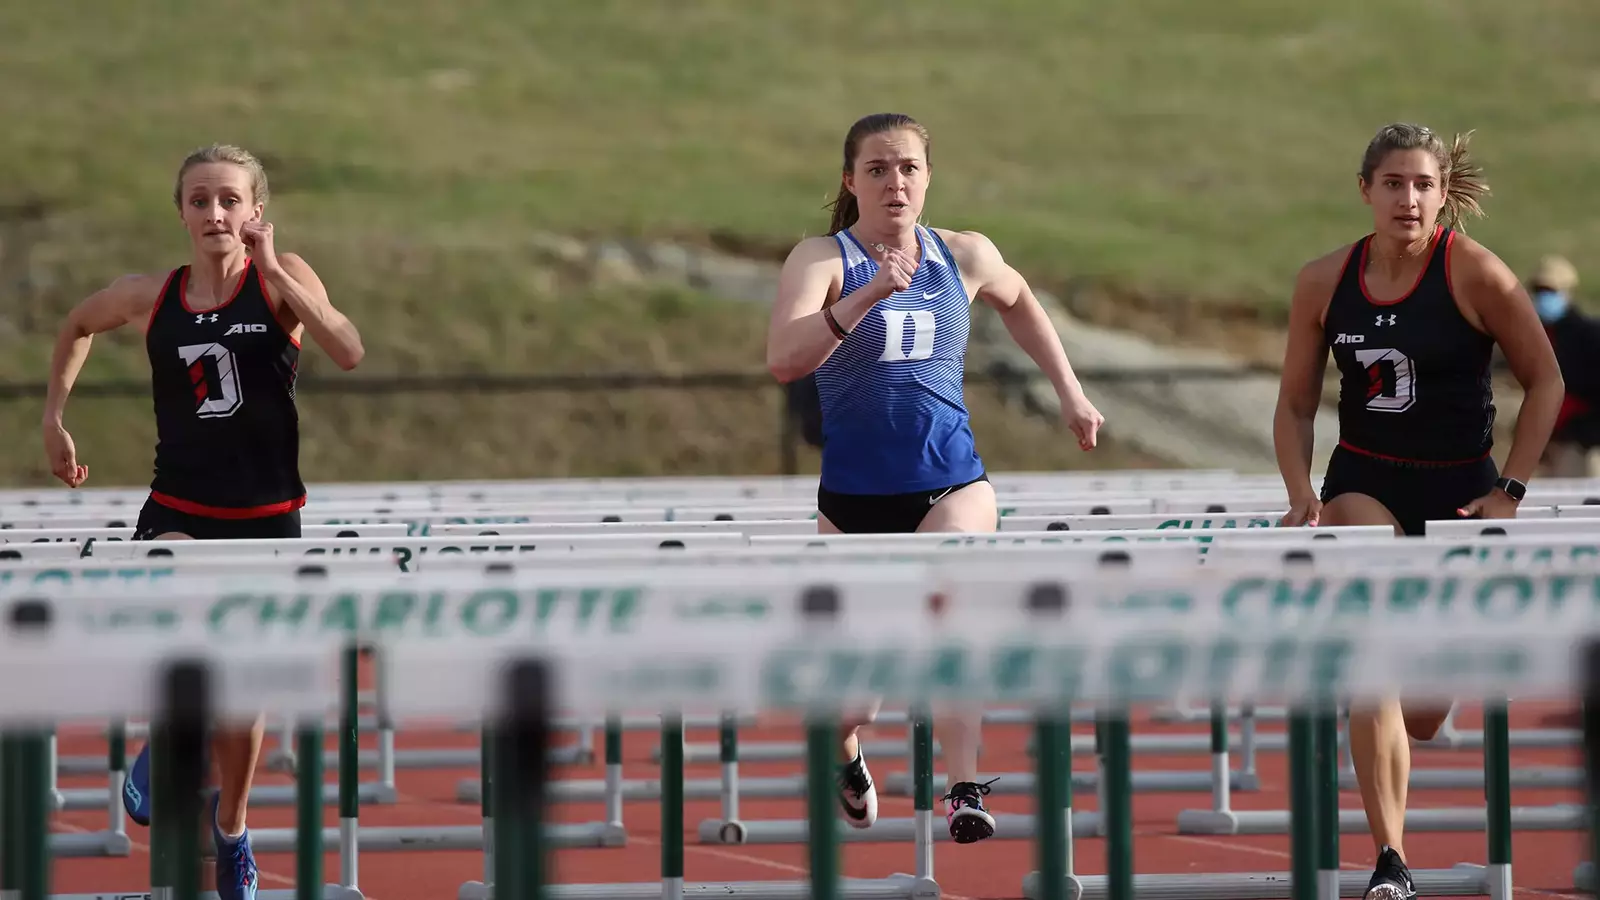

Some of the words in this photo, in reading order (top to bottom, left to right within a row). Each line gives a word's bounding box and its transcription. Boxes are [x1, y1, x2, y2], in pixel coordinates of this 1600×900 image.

[223, 323, 268, 336] A10
[877, 309, 937, 362] D
[1334, 333, 1365, 344] A10
[178, 342, 244, 419] D
[1355, 348, 1417, 413] D
